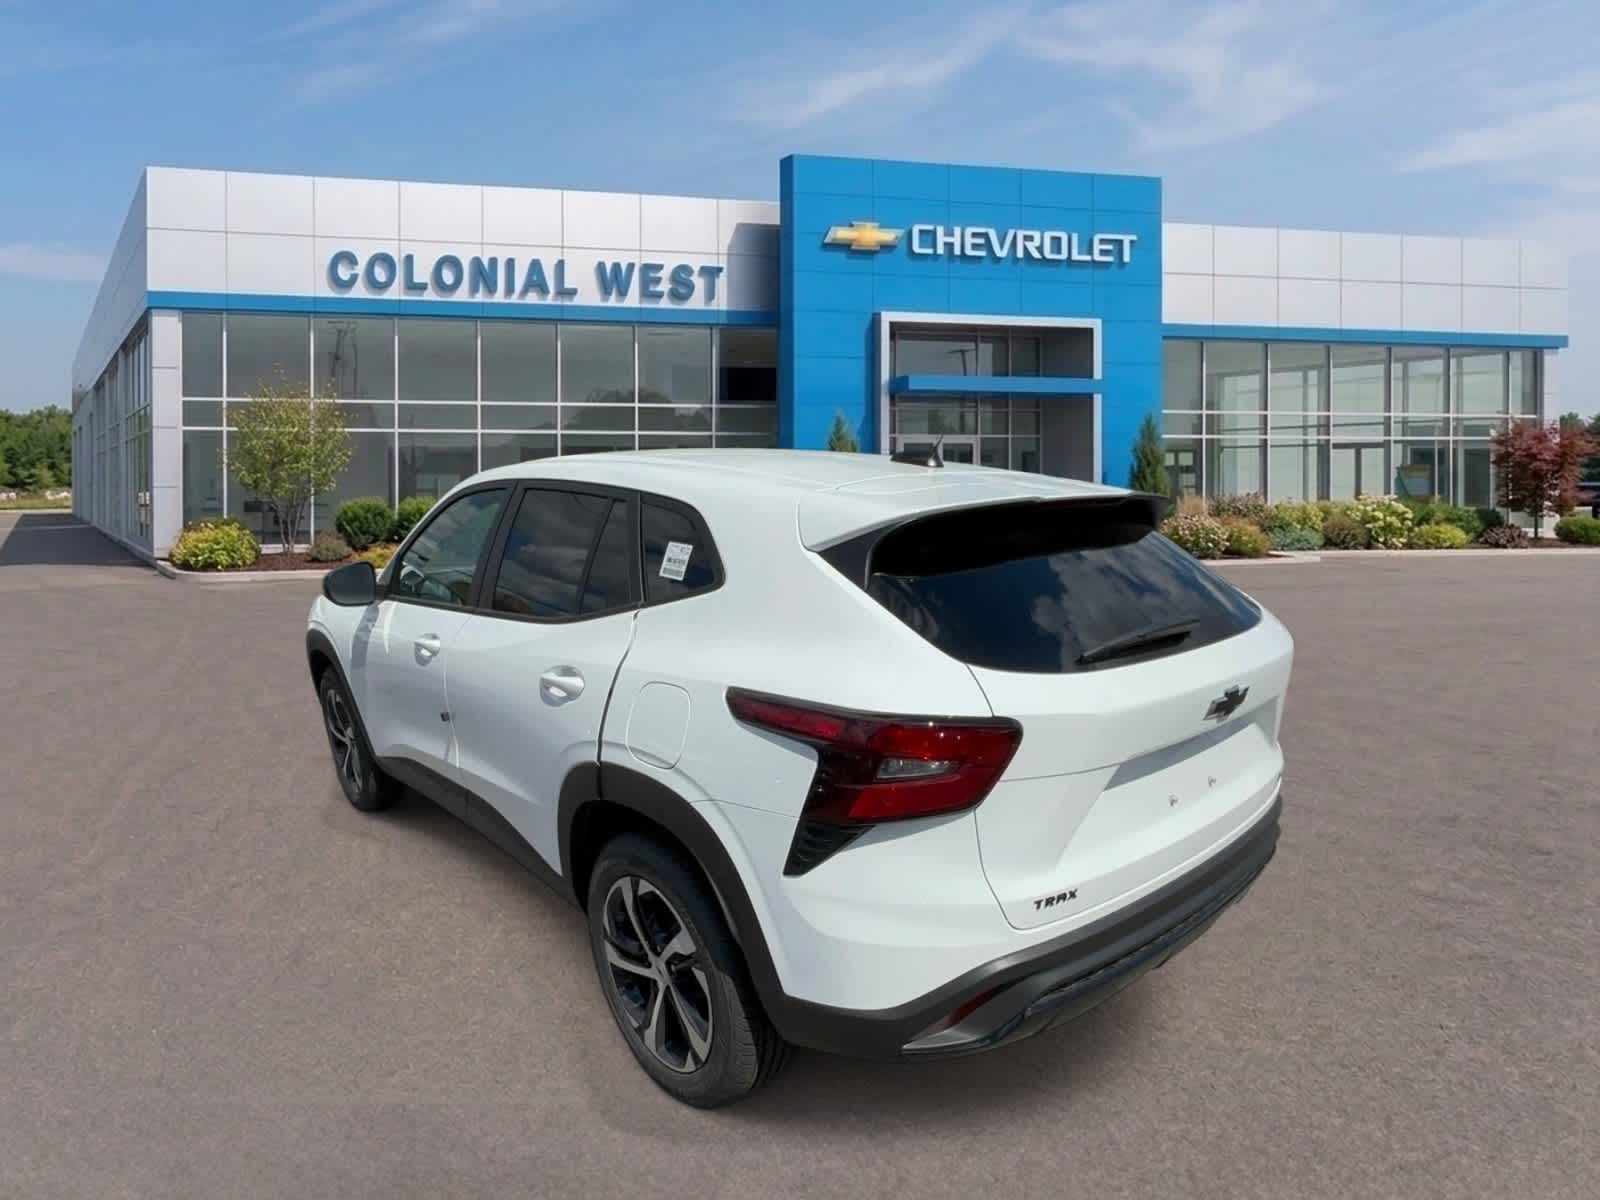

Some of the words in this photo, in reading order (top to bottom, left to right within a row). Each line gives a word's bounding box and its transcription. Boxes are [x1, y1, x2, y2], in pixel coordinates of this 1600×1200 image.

[911, 223, 1138, 263] CHEVROLET
[327, 250, 579, 301] COLONIAL
[595, 260, 724, 305] WEST
[1033, 888, 1078, 910] TRAX
